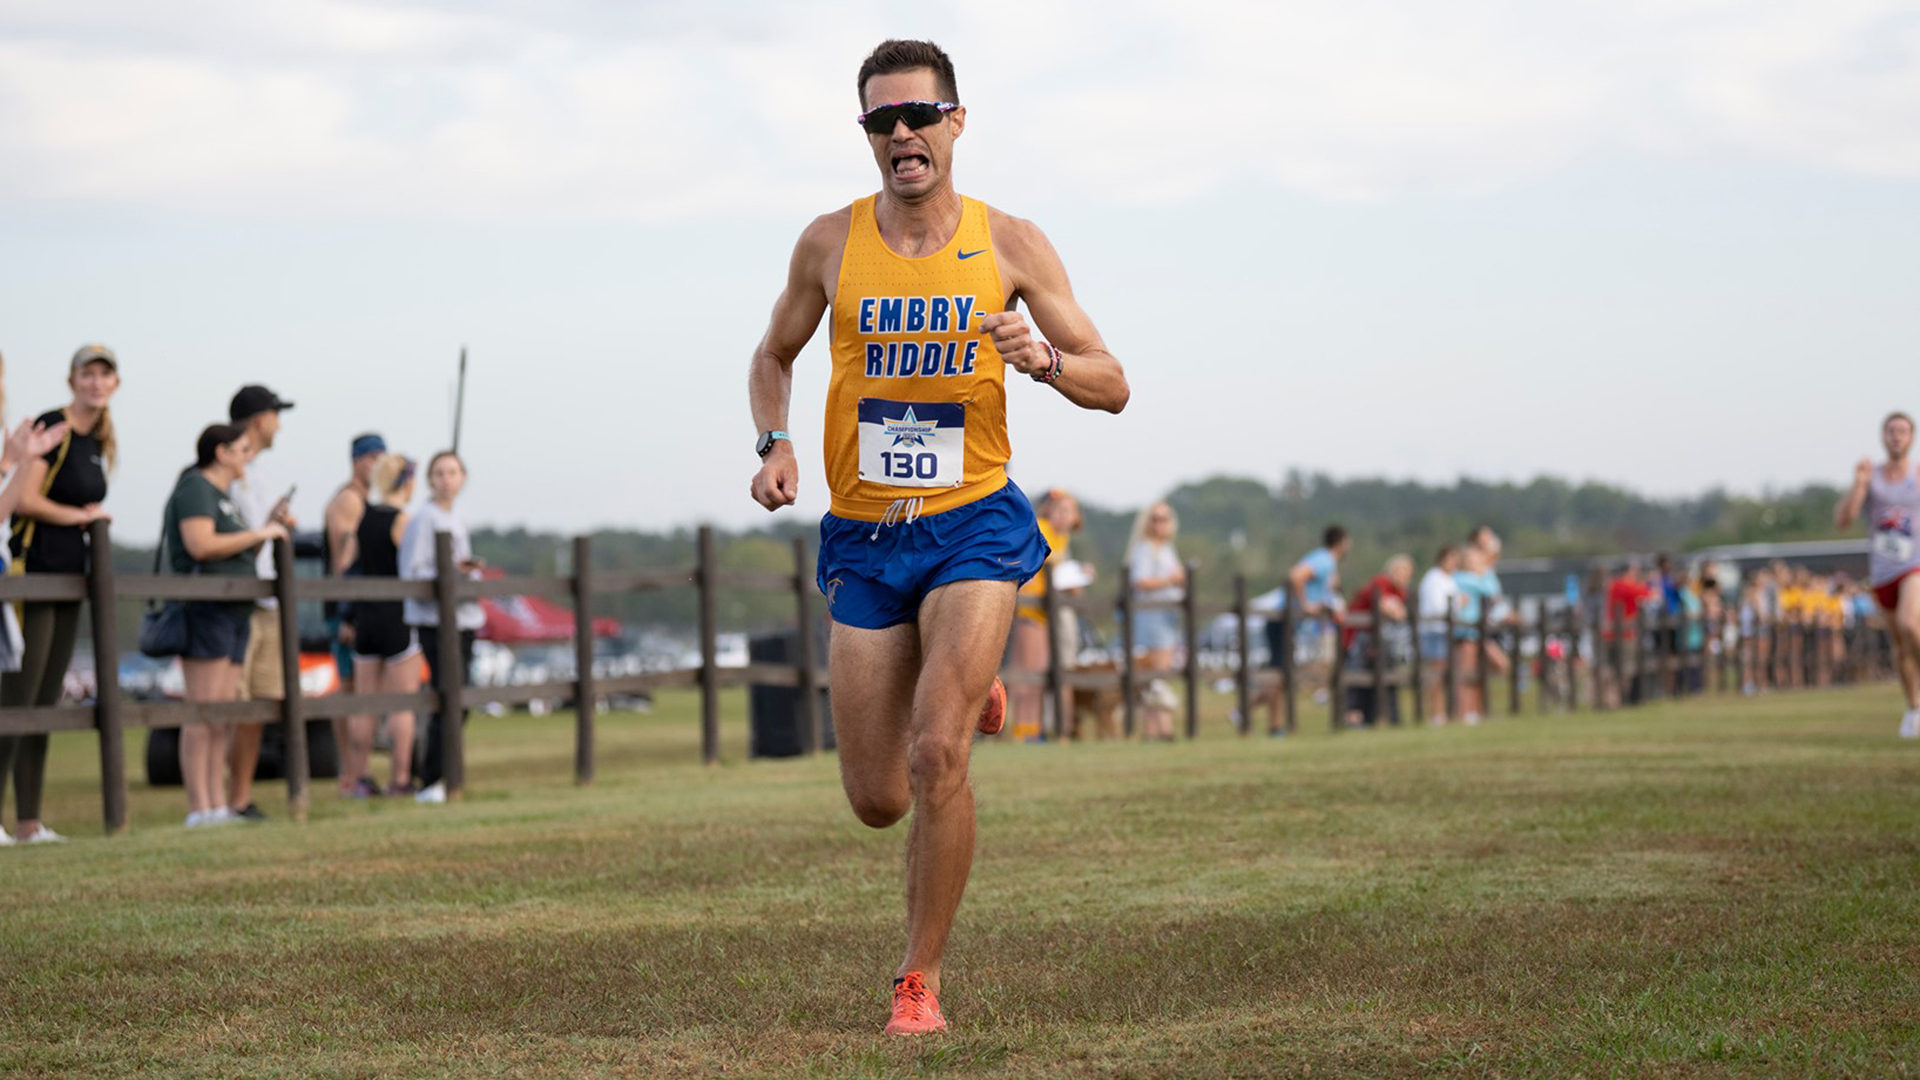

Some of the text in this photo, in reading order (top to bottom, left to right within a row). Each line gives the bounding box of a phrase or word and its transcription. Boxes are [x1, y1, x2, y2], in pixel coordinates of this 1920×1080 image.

[859, 295, 986, 334] EMBRY-
[865, 340, 980, 377] RIDDLE
[880, 451, 938, 479] 130
